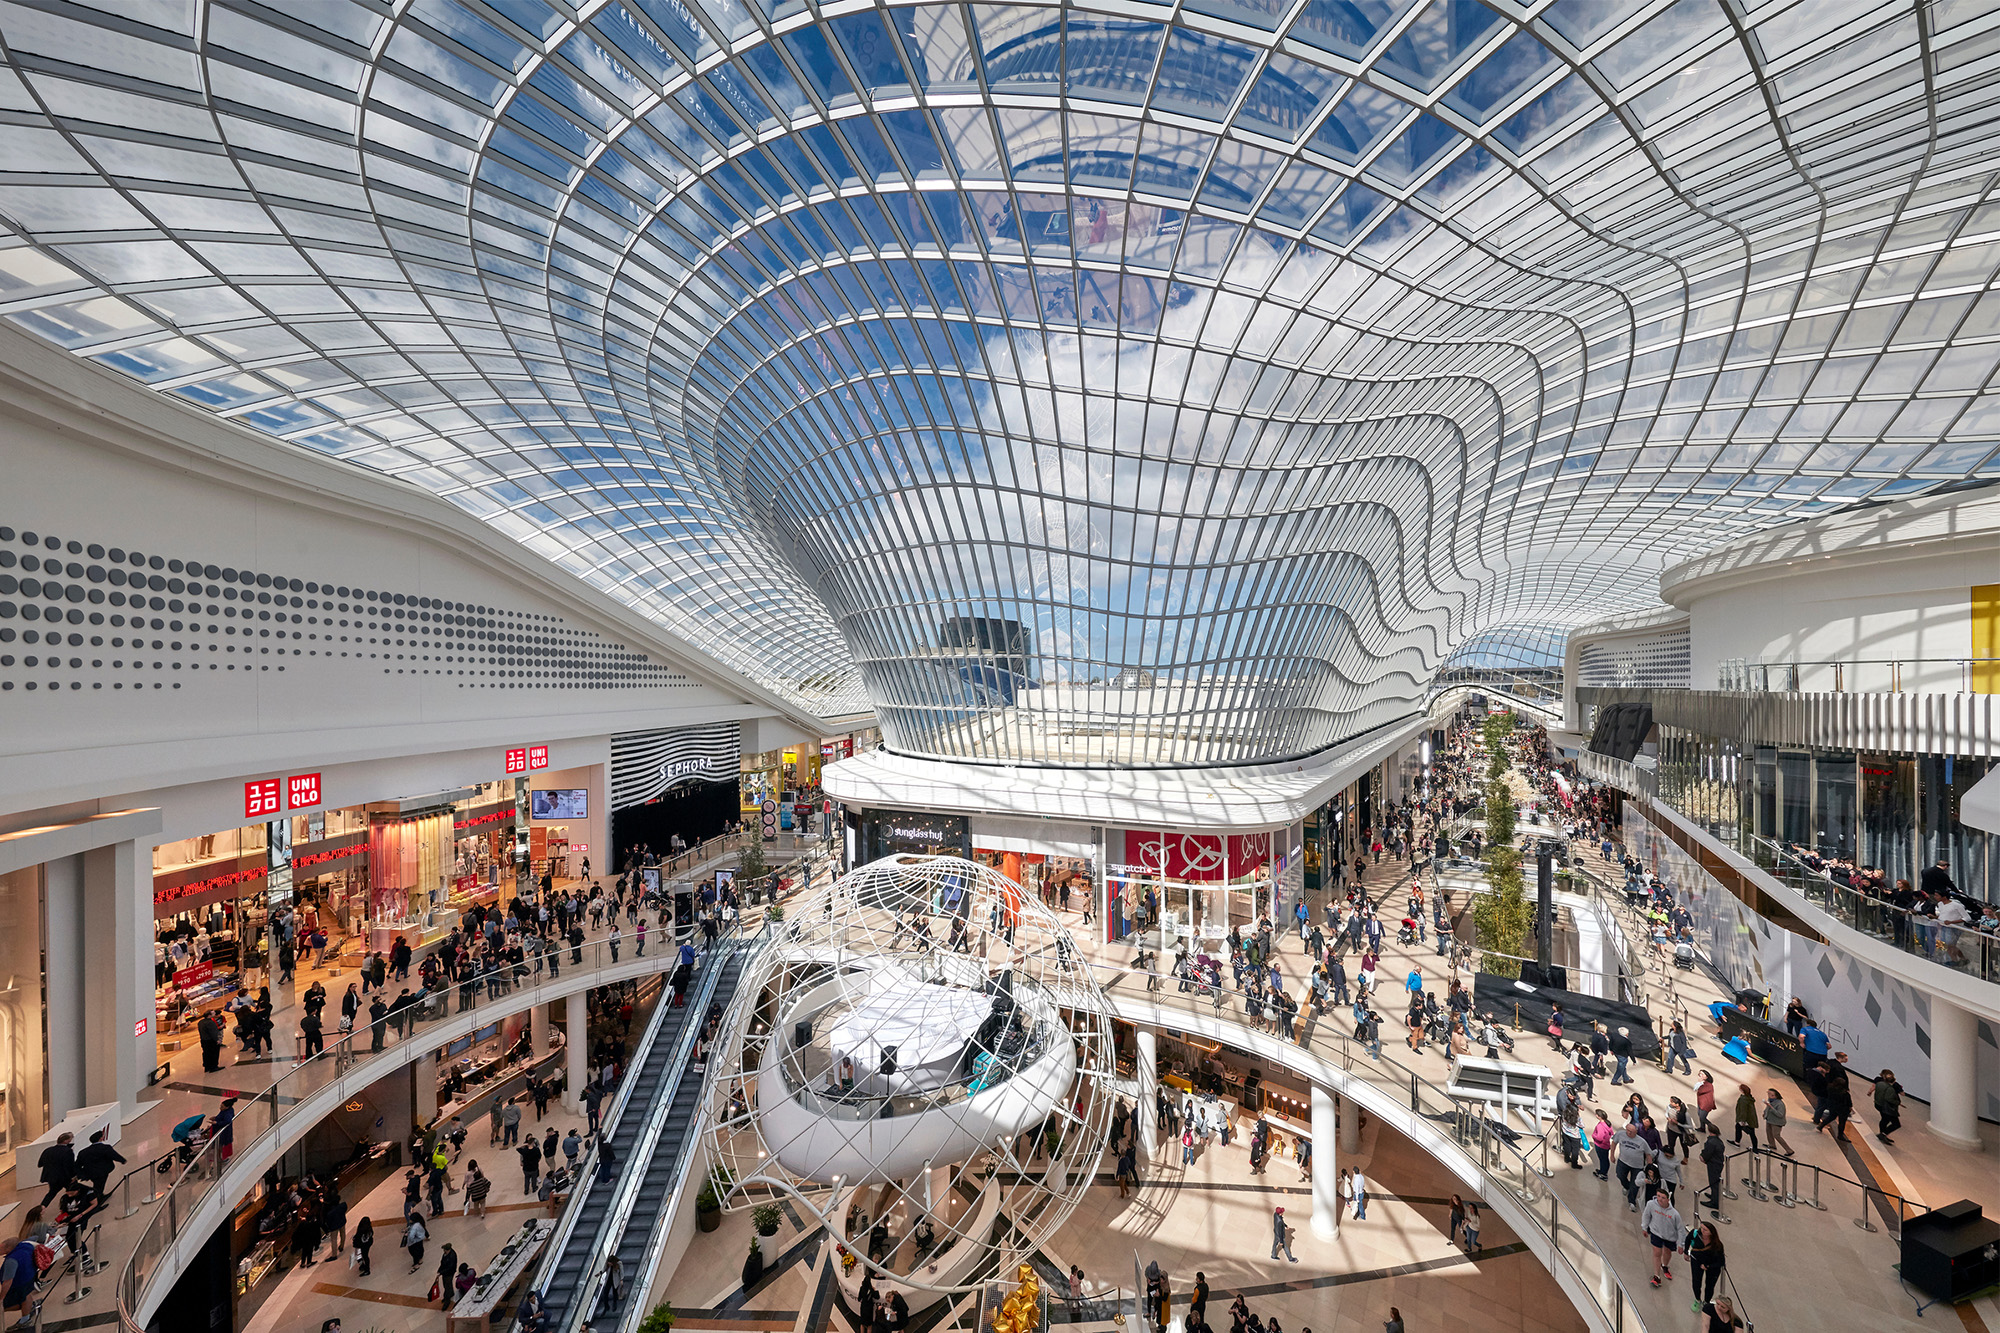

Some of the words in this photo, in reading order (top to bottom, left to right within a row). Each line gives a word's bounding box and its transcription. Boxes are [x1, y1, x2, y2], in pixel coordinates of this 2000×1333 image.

[531, 748, 546, 758] UNI
[531, 757, 547, 768] QLO
[659, 757, 712, 779] SEPHORA
[291, 777, 316, 792] UNI
[291, 790, 318, 807] QLO
[894, 827, 928, 840] sunglass
[929, 829, 944, 840] hut
[1111, 863, 1146, 874] swatch
[157, 886, 181, 898] BETTER
